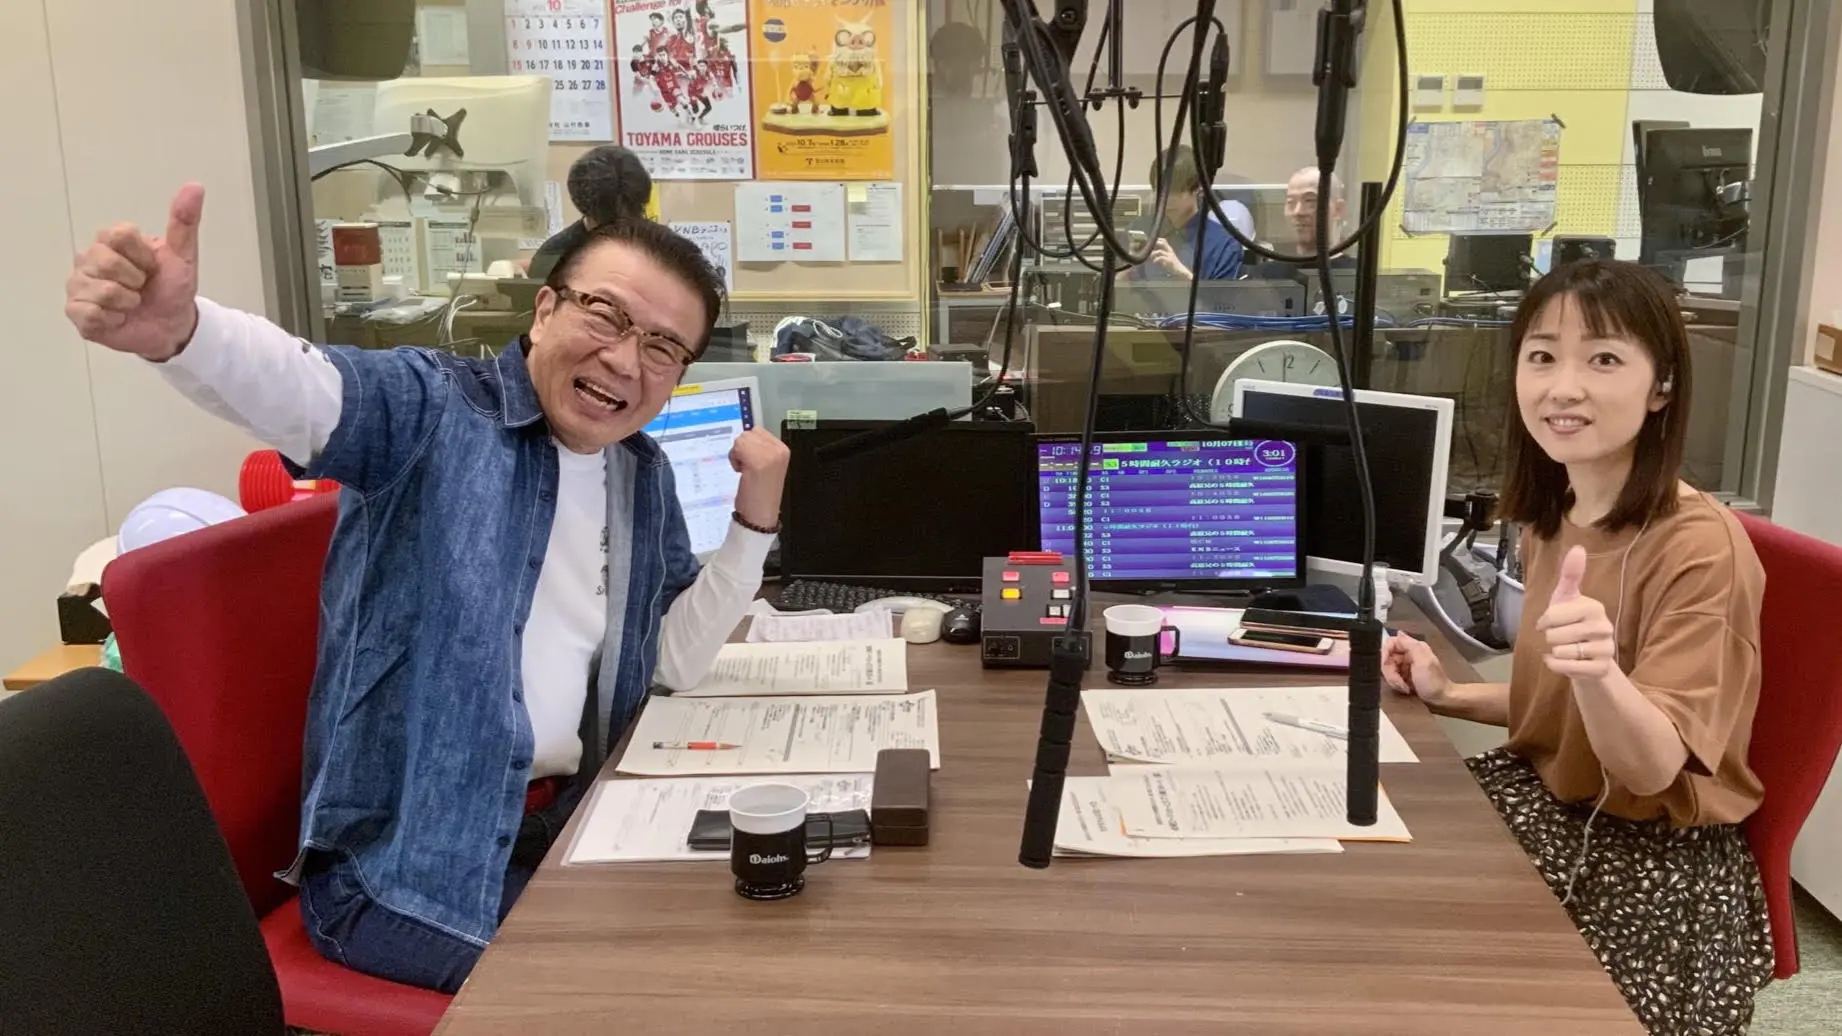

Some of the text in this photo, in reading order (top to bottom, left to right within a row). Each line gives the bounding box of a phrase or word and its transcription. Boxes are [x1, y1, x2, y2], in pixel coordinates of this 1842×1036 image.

[525, 19, 531, 29] 2
[539, 19, 545, 29] 3
[553, 19, 558, 29] 4
[566, 19, 572, 29] 5
[580, 19, 586, 29] 6
[593, 19, 599, 29] 7
[526, 39, 532, 49] 9
[538, 39, 548, 49] 10
[552, 39, 560, 49] 11
[566, 39, 575, 49] 12
[580, 39, 589, 49] 13
[593, 39, 603, 49] 14
[526, 60, 536, 70] 16
[540, 60, 549, 70] 17
[553, 60, 563, 70] 18
[567, 60, 577, 70] 19
[581, 60, 591, 70] 20
[594, 60, 604, 70] 21
[555, 80, 606, 90] 25 26 27 28
[627, 132, 748, 146] TOYAMA GROUSES
[1262, 449, 1286, 457] 3:01
